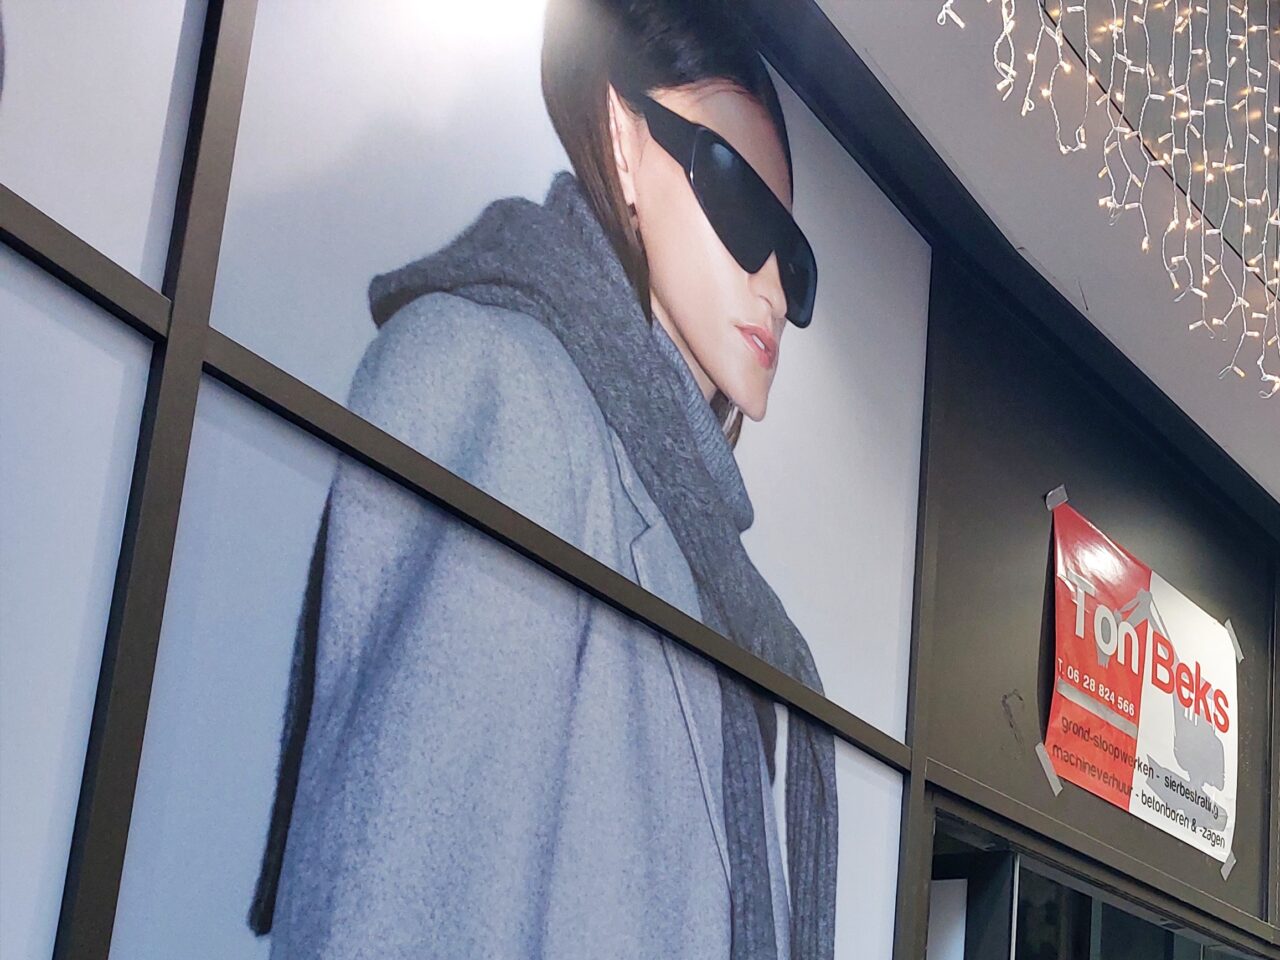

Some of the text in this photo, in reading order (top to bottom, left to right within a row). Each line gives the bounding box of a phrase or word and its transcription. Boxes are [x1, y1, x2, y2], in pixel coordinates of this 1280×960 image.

[1066, 567, 1230, 734] Ton Beks
[1067, 665, 1080, 683] 06
[1083, 675, 1096, 692] 28
[1099, 684, 1115, 705] 824
[1117, 697, 1135, 716] 566
[1052, 744, 1133, 796] machineverhuur
[1141, 789, 1190, 829] betonboren
[1191, 818, 1198, 834] &
